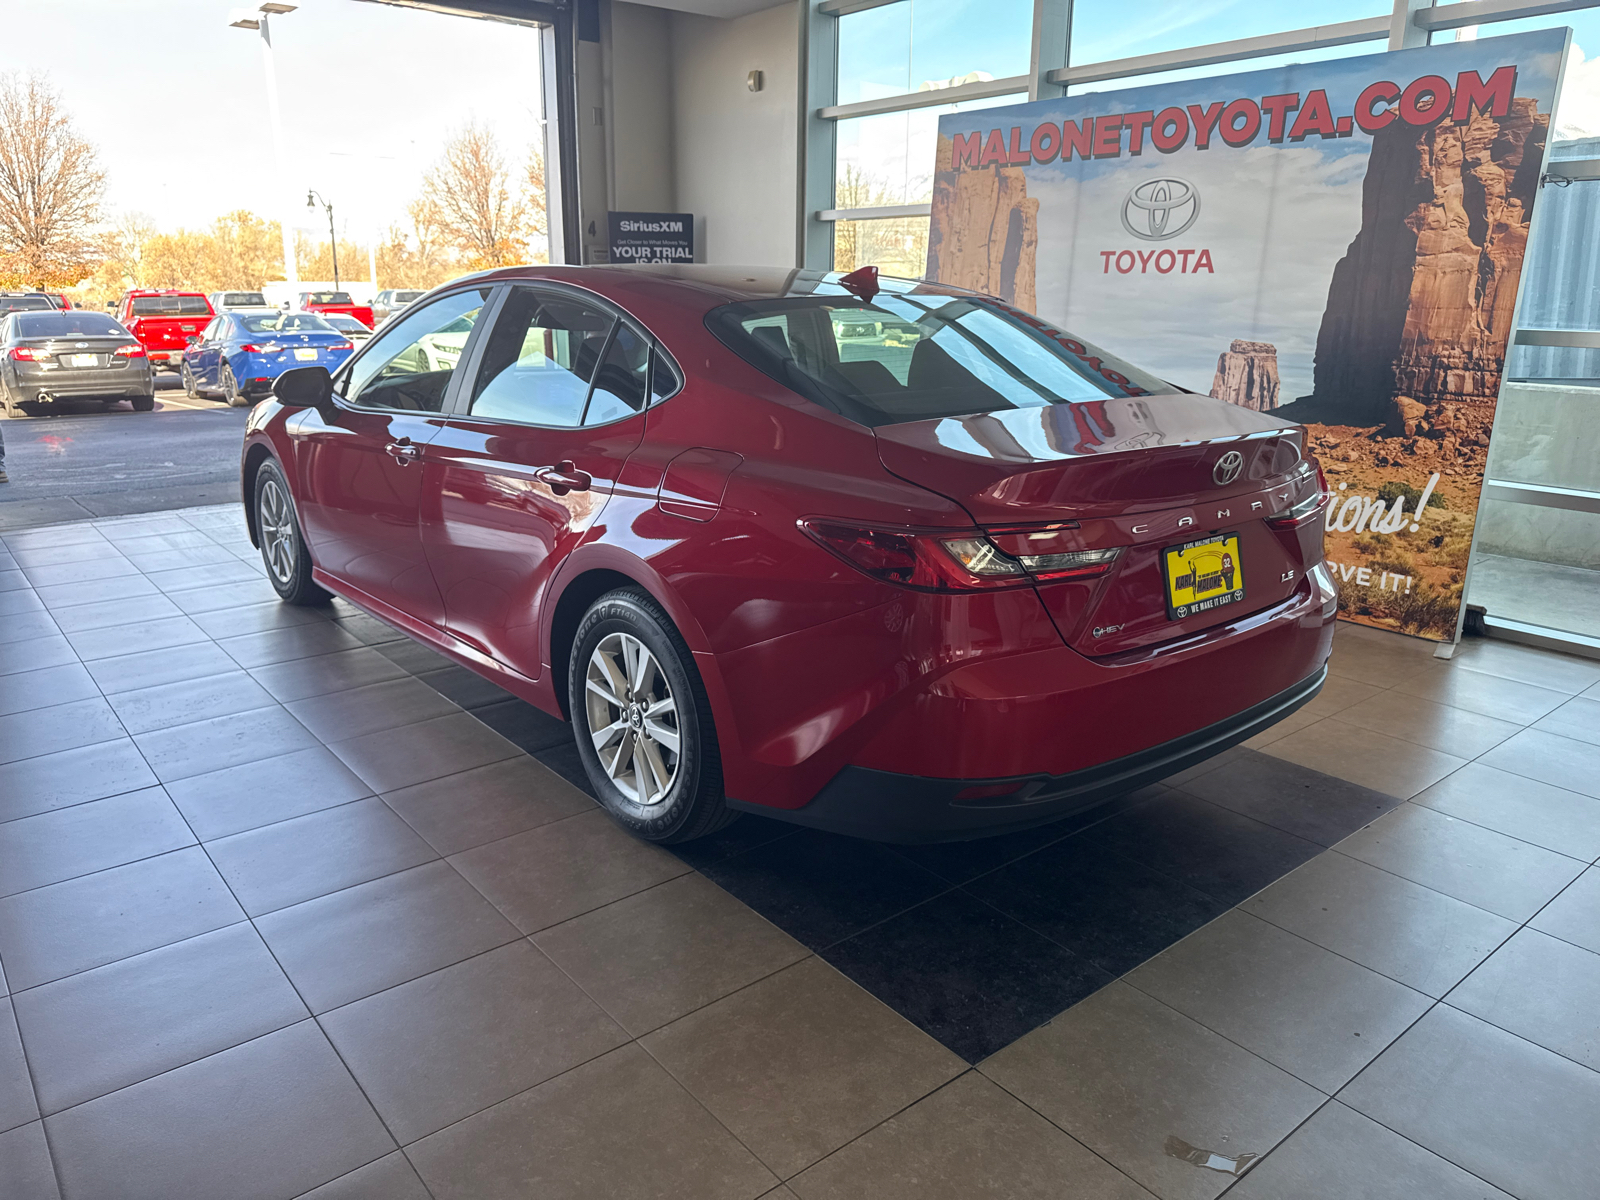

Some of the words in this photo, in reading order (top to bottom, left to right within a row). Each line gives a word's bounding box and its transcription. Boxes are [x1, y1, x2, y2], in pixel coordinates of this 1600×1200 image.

[952, 65, 1518, 173] MALONETOYOTA.COM
[588, 220, 596, 237] 4
[620, 221, 683, 232] SiriusXM
[613, 246, 651, 258] YOUR
[653, 247, 693, 258] TRIAL
[1100, 249, 1215, 274] TOYOTA
[1325, 473, 1440, 534] ions!
[1131, 493, 1289, 534] CAMRY
[1183, 542, 1195, 550] KARL
[1223, 557, 1231, 568] 32
[1175, 573, 1193, 591] KARL
[1197, 574, 1223, 594] MALONE
[1281, 570, 1295, 583] LE
[1380, 571, 1413, 594] IT!
[1191, 604, 1199, 613] WE
[1200, 600, 1214, 611] MAKE
[1213, 598, 1219, 606] IT
[1219, 594, 1231, 604] EASY
